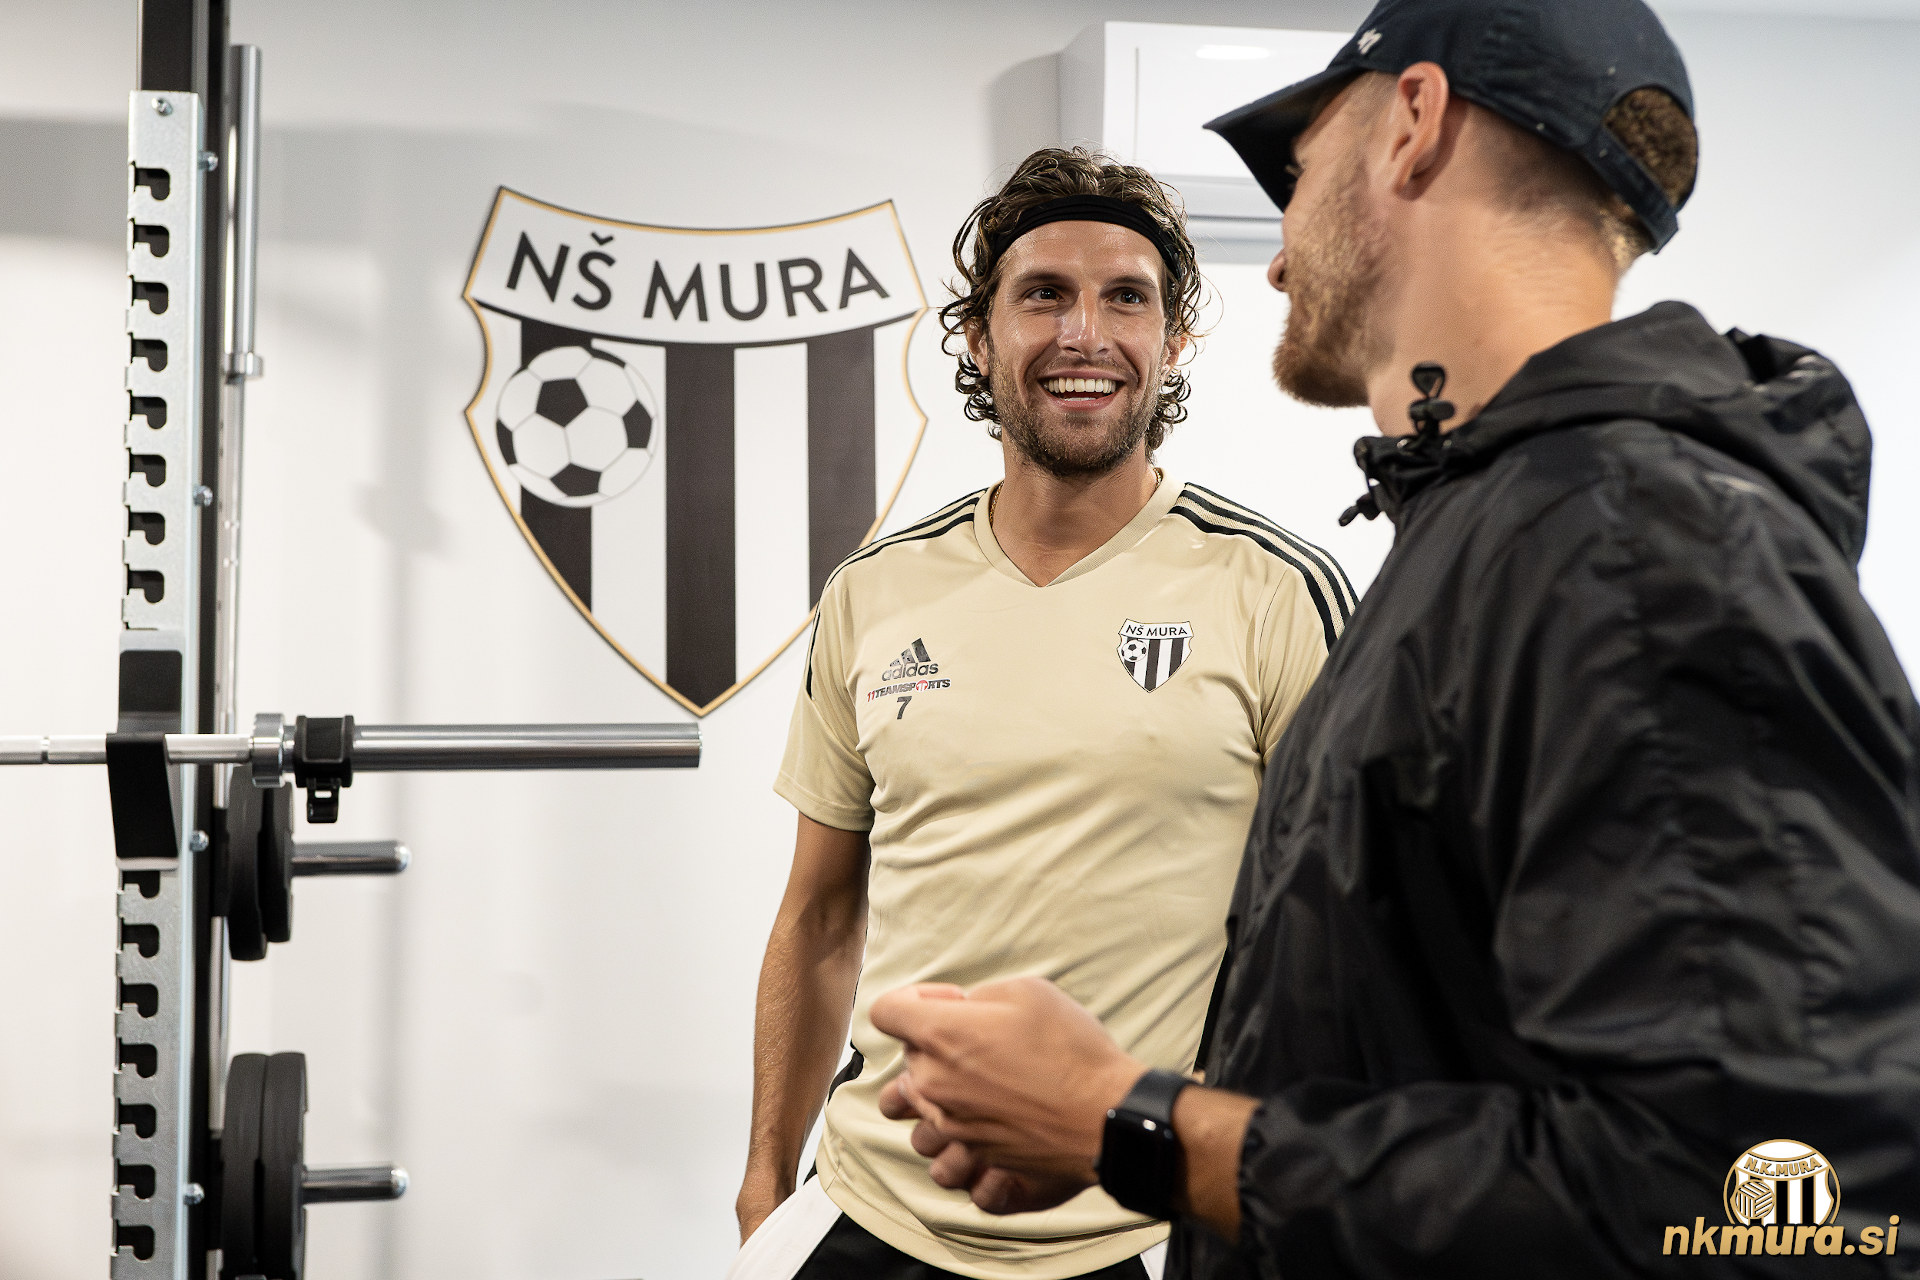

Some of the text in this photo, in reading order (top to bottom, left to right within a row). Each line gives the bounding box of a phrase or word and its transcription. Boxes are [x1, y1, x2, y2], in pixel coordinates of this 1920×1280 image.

[506, 231, 891, 322] NŠ MURA
[1125, 624, 1188, 637] NŠ MURA
[881, 662, 939, 682] adidas
[896, 695, 913, 720] 7
